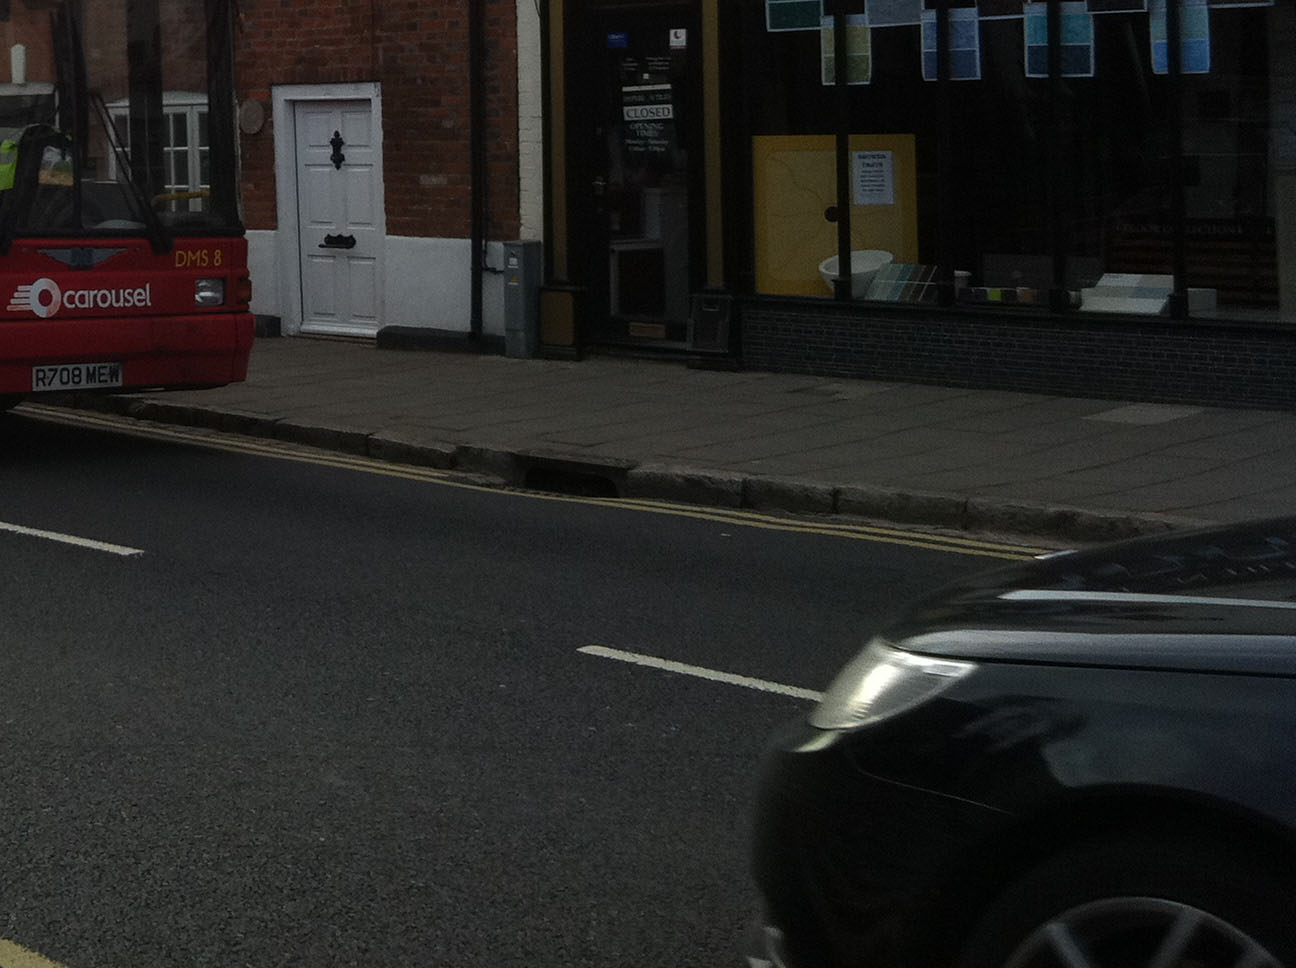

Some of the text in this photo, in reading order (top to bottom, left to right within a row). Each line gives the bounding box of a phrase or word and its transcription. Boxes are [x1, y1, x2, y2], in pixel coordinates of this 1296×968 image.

[626, 107, 670, 119] CLOSED
[175, 249, 223, 267] DMS 8
[63, 283, 152, 309] carousel
[35, 364, 120, 387] R708 MEW
